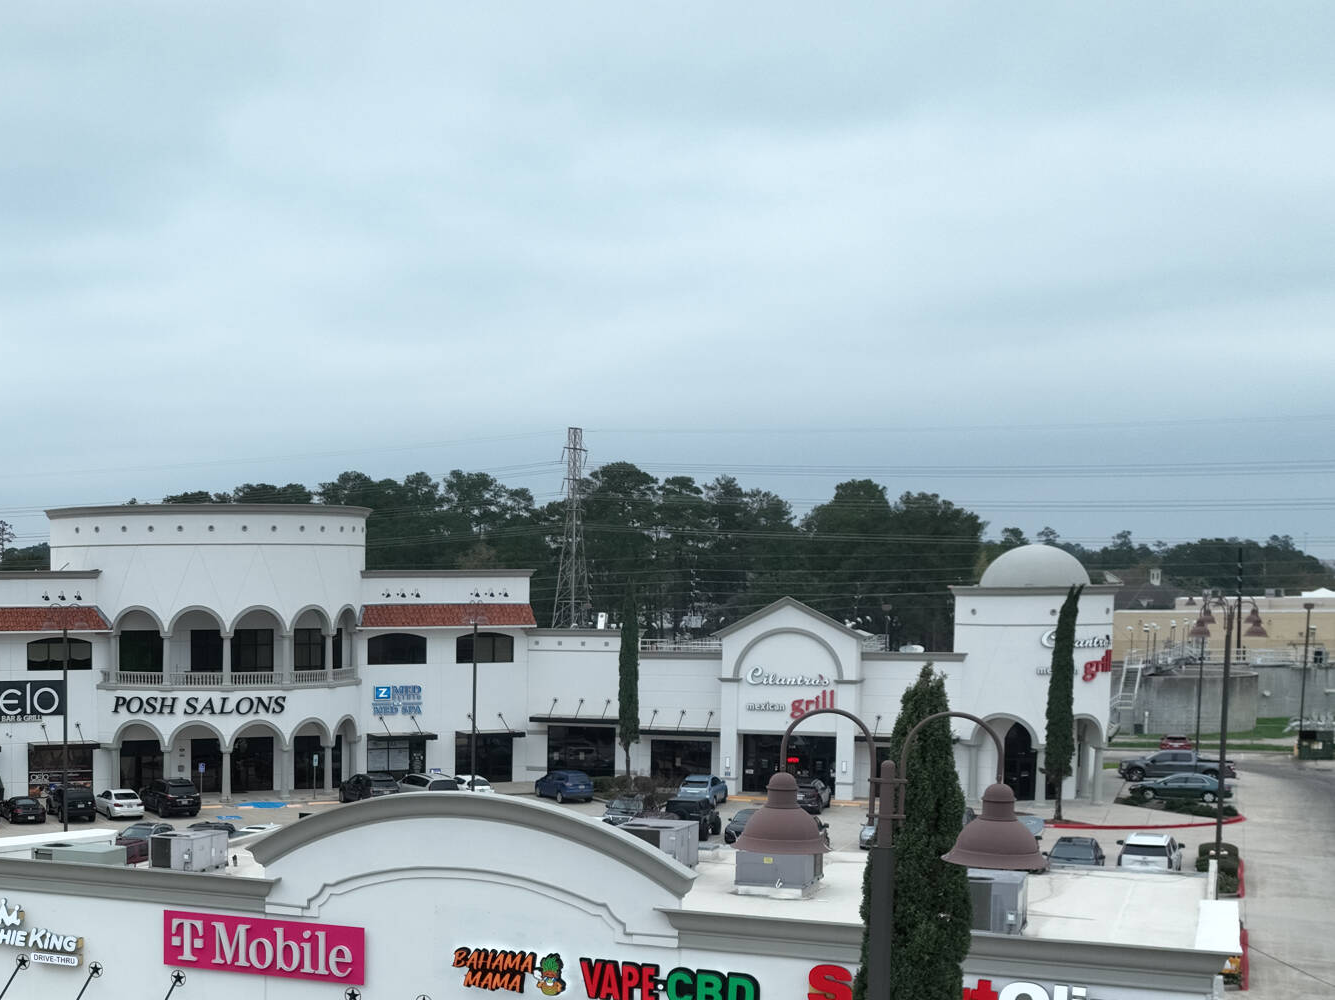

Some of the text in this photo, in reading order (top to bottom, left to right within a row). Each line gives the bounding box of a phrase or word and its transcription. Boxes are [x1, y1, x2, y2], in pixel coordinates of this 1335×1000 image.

[746, 665, 830, 686] Cilantro's
[112, 694, 287, 716] POSH SALONS
[746, 689, 835, 719] mexican grill
[1, 714, 16, 722] BAR
[23, 714, 43, 722] GRILL
[32, 952, 77, 966] DRIVE-THRU
[211, 920, 354, 979] Mobile
[452, 946, 537, 974] BAHAMA
[463, 968, 525, 994] MAMA
